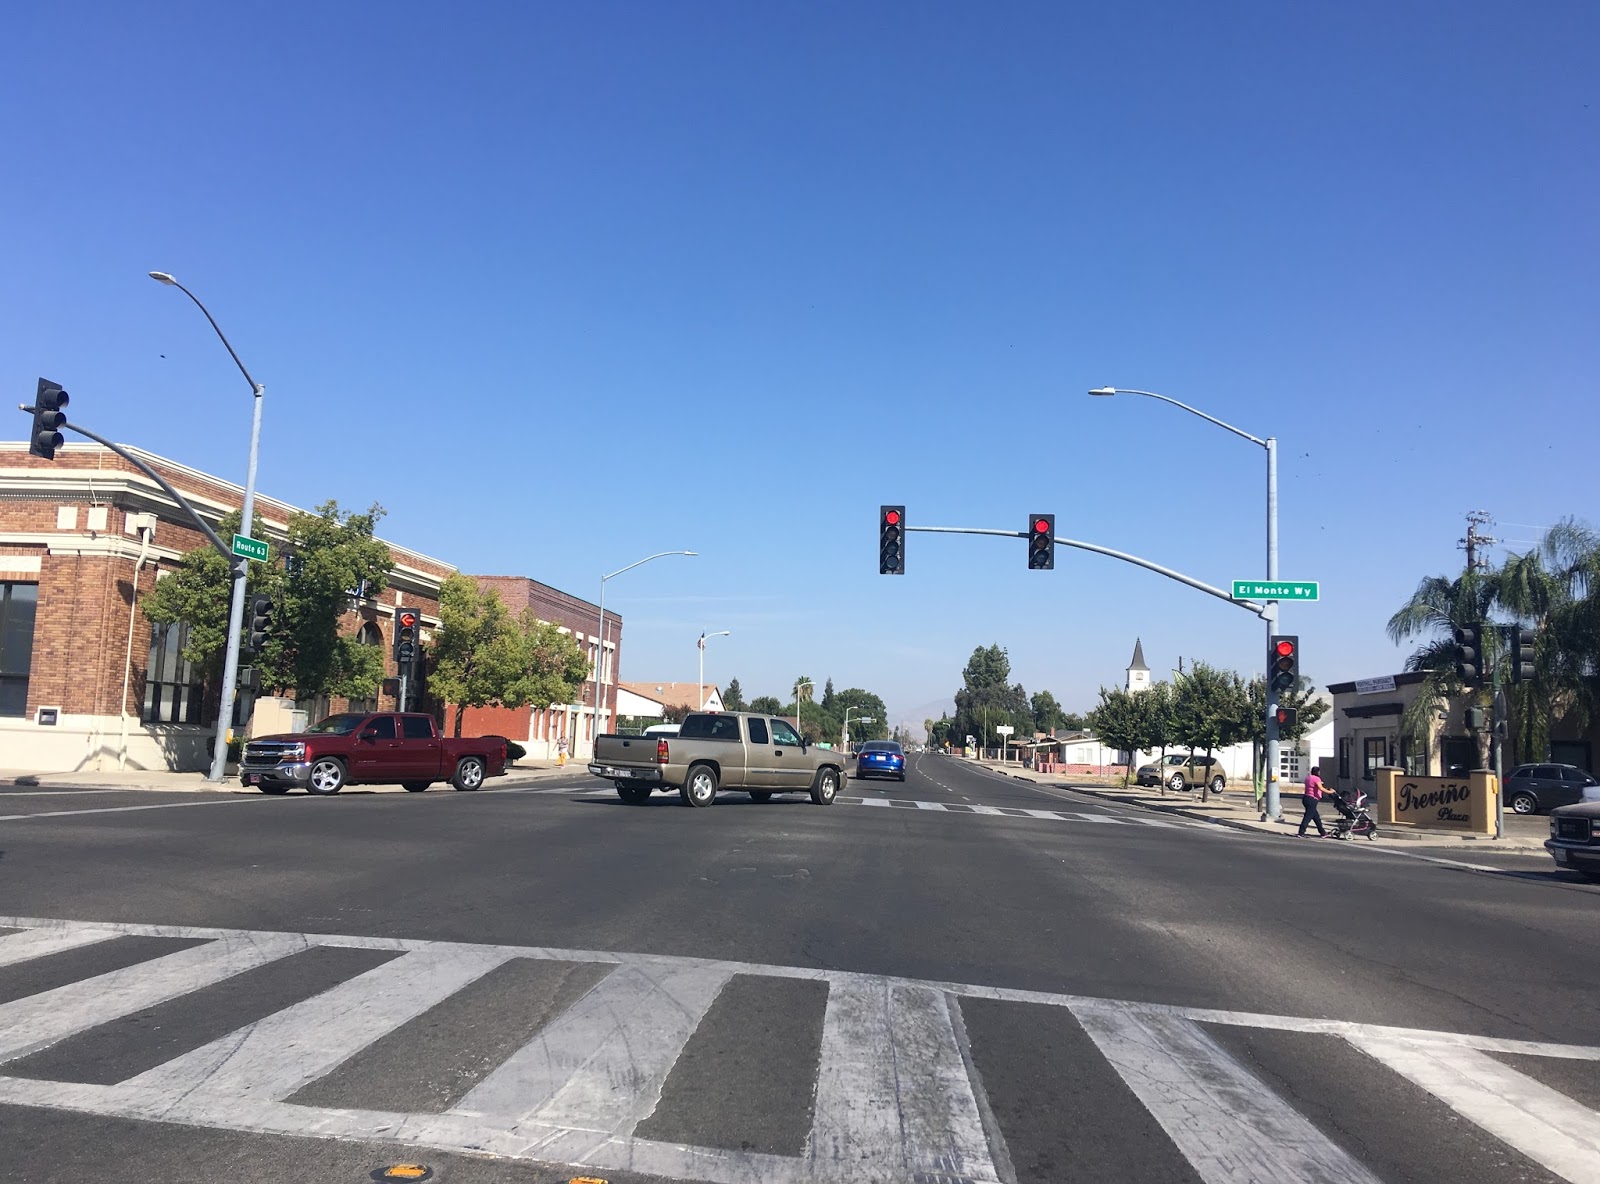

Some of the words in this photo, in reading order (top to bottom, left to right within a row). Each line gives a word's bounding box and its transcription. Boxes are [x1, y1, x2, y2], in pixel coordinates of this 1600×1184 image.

[236, 541, 255, 553] Route
[257, 547, 265, 555] 63
[1239, 586, 1250, 594] El
[1255, 586, 1290, 595] Monte
[1294, 587, 1311, 596] Wy
[1398, 783, 1470, 812] Treviño
[1437, 808, 1470, 821] Plaza
